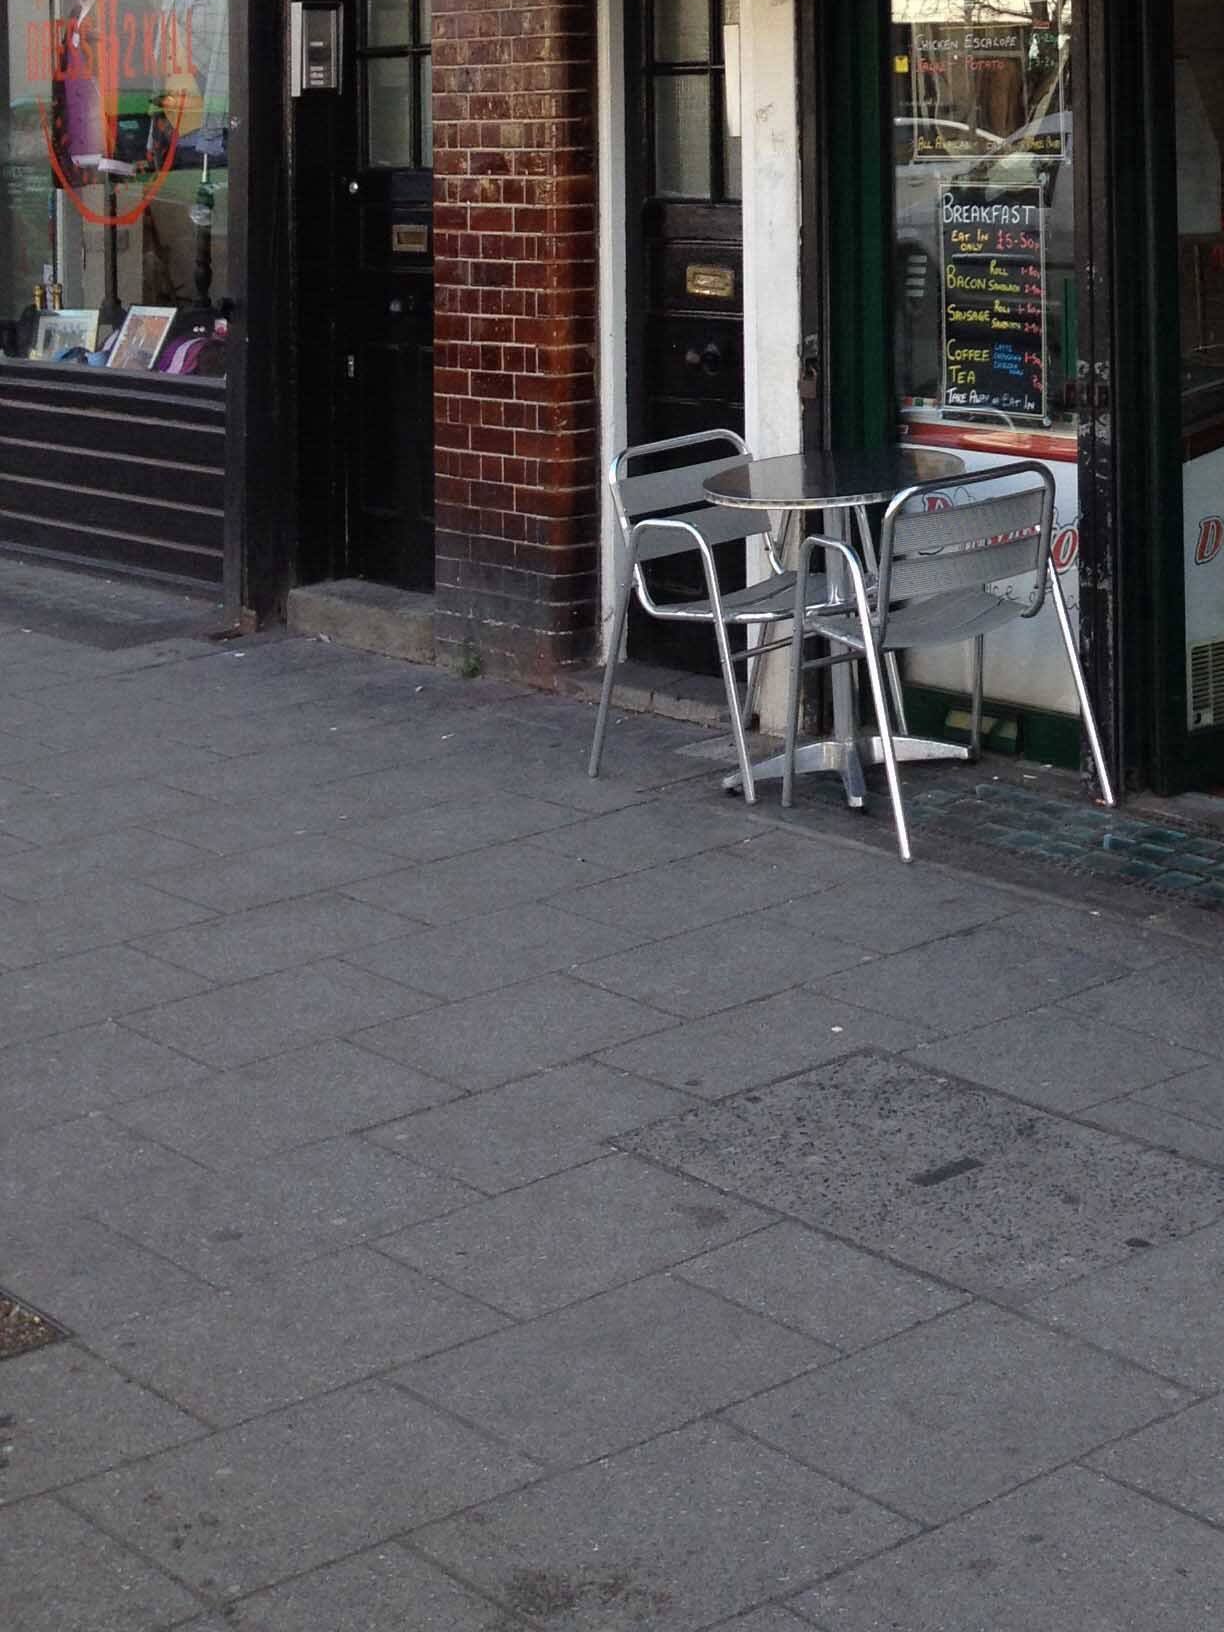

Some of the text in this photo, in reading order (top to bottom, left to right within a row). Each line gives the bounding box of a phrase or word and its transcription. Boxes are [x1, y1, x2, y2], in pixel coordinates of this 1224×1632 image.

[943, 192, 1036, 225] BREAKFAST
[946, 338, 990, 362] COFFEE
[948, 364, 976, 385] TEA
